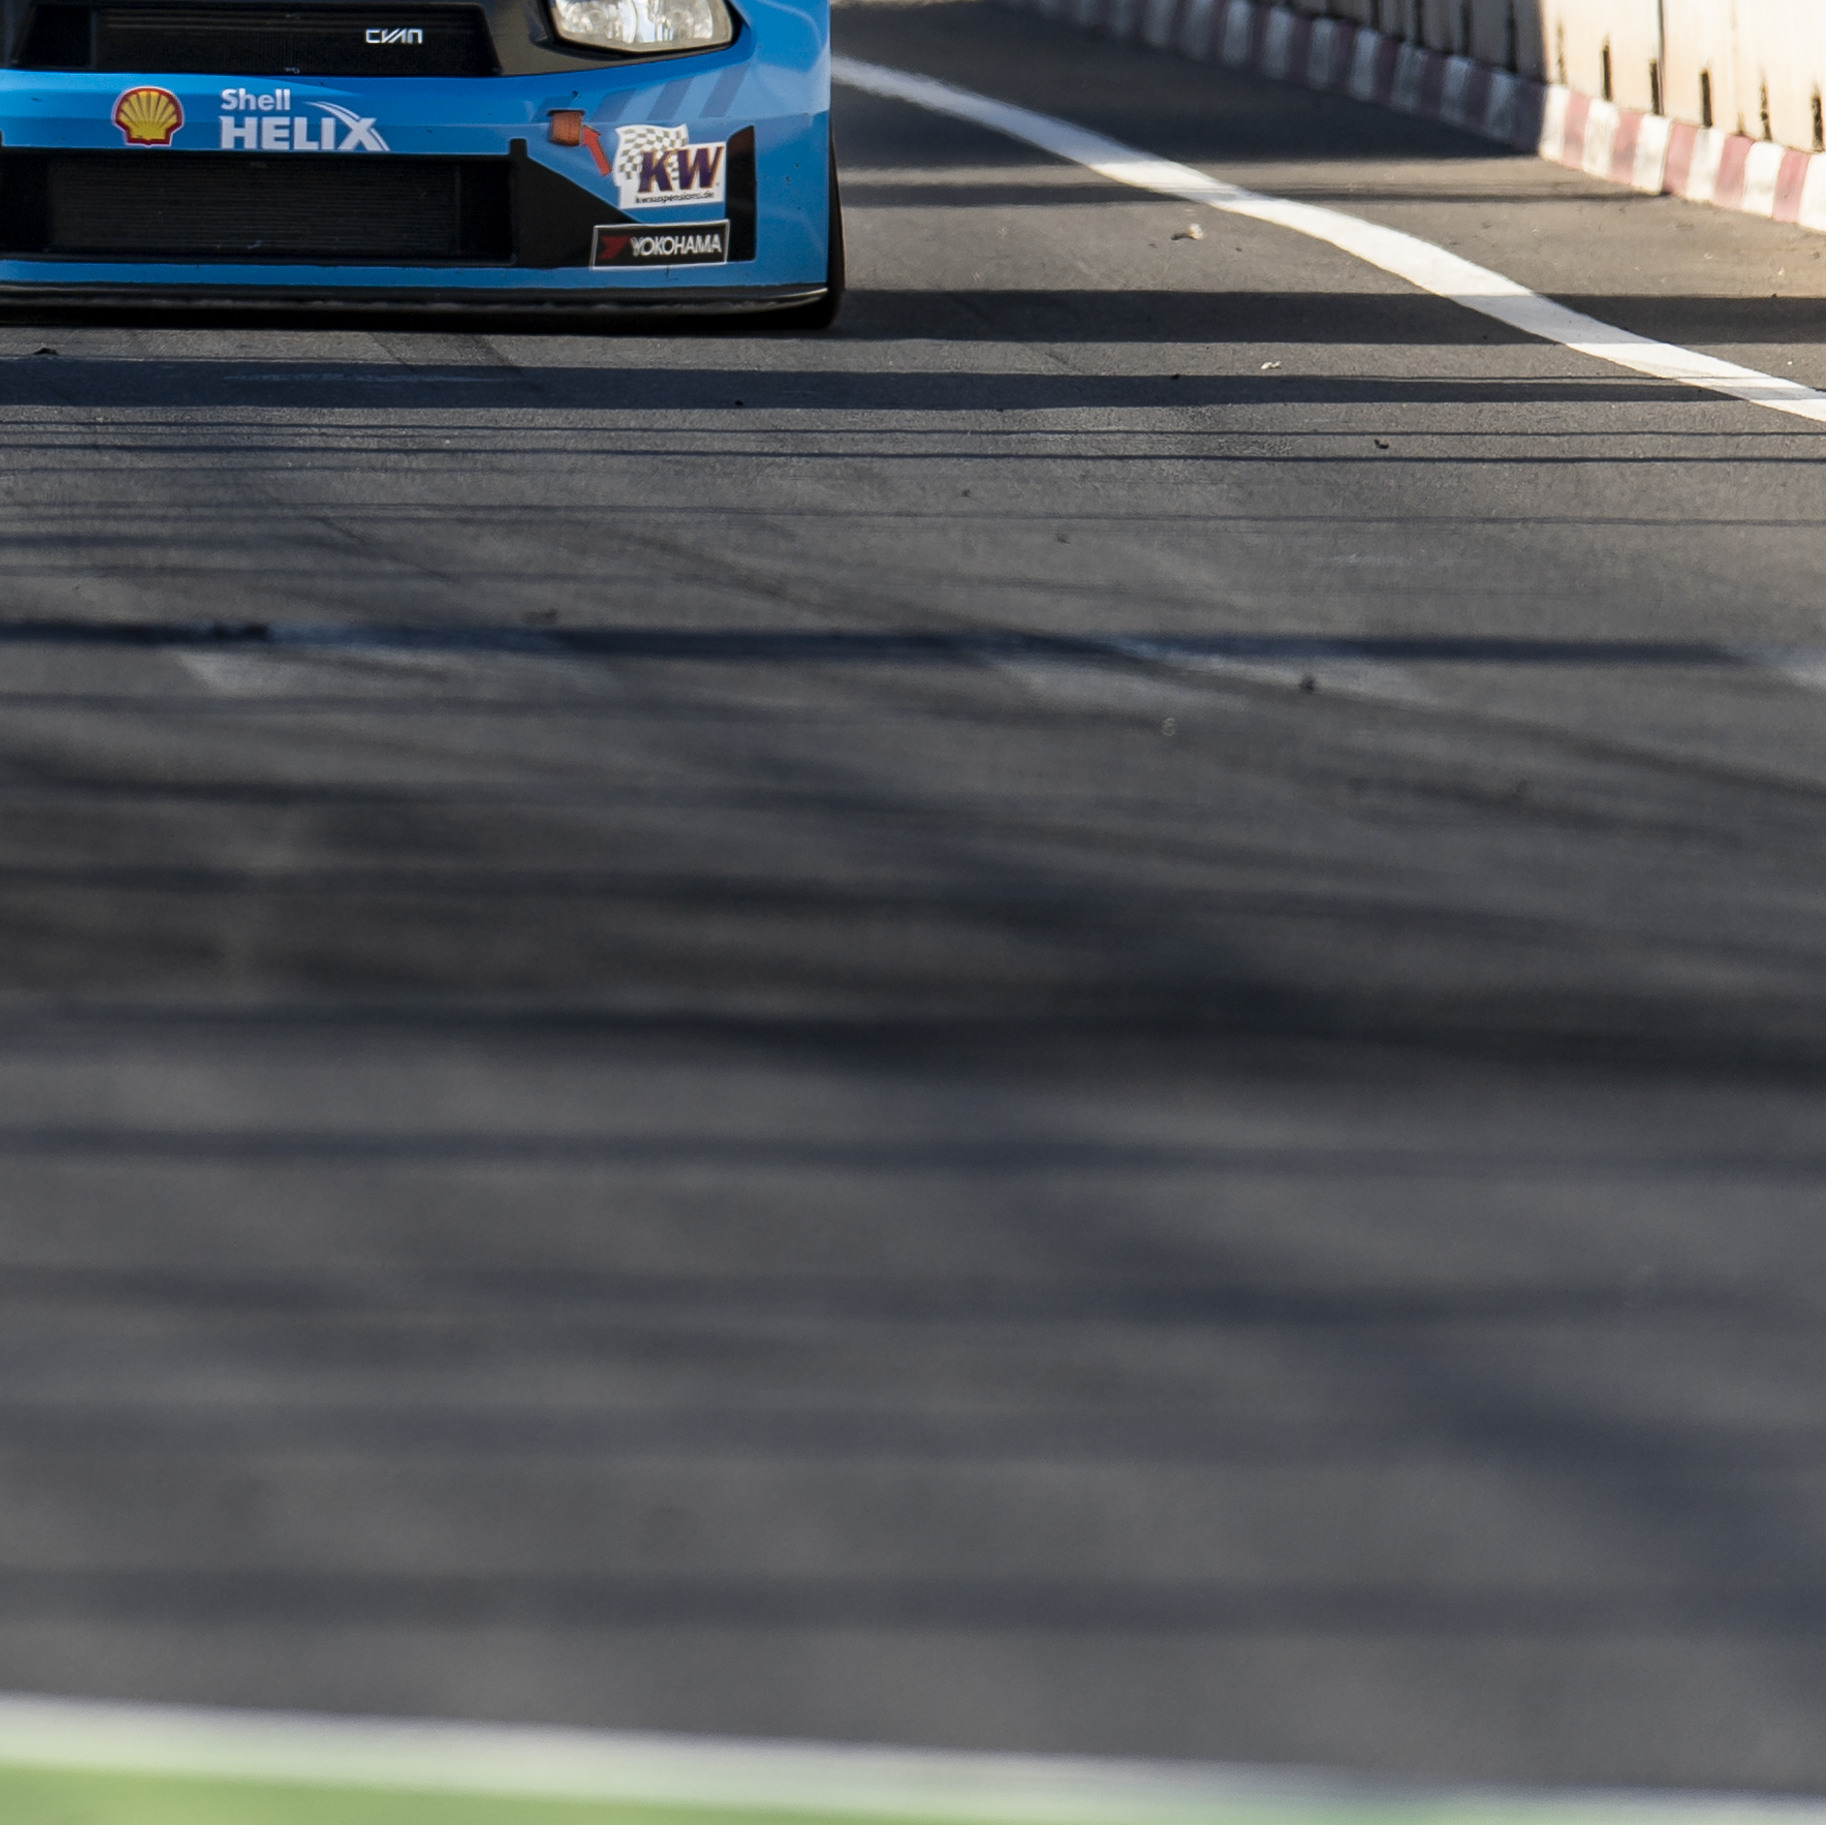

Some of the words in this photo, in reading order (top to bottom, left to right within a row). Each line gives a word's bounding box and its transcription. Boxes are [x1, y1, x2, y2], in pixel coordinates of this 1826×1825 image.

[220, 88, 291, 111] Shell
[218, 114, 391, 152] HELIX
[637, 145, 725, 194] KW
[629, 233, 723, 257] YOKOHAMA
